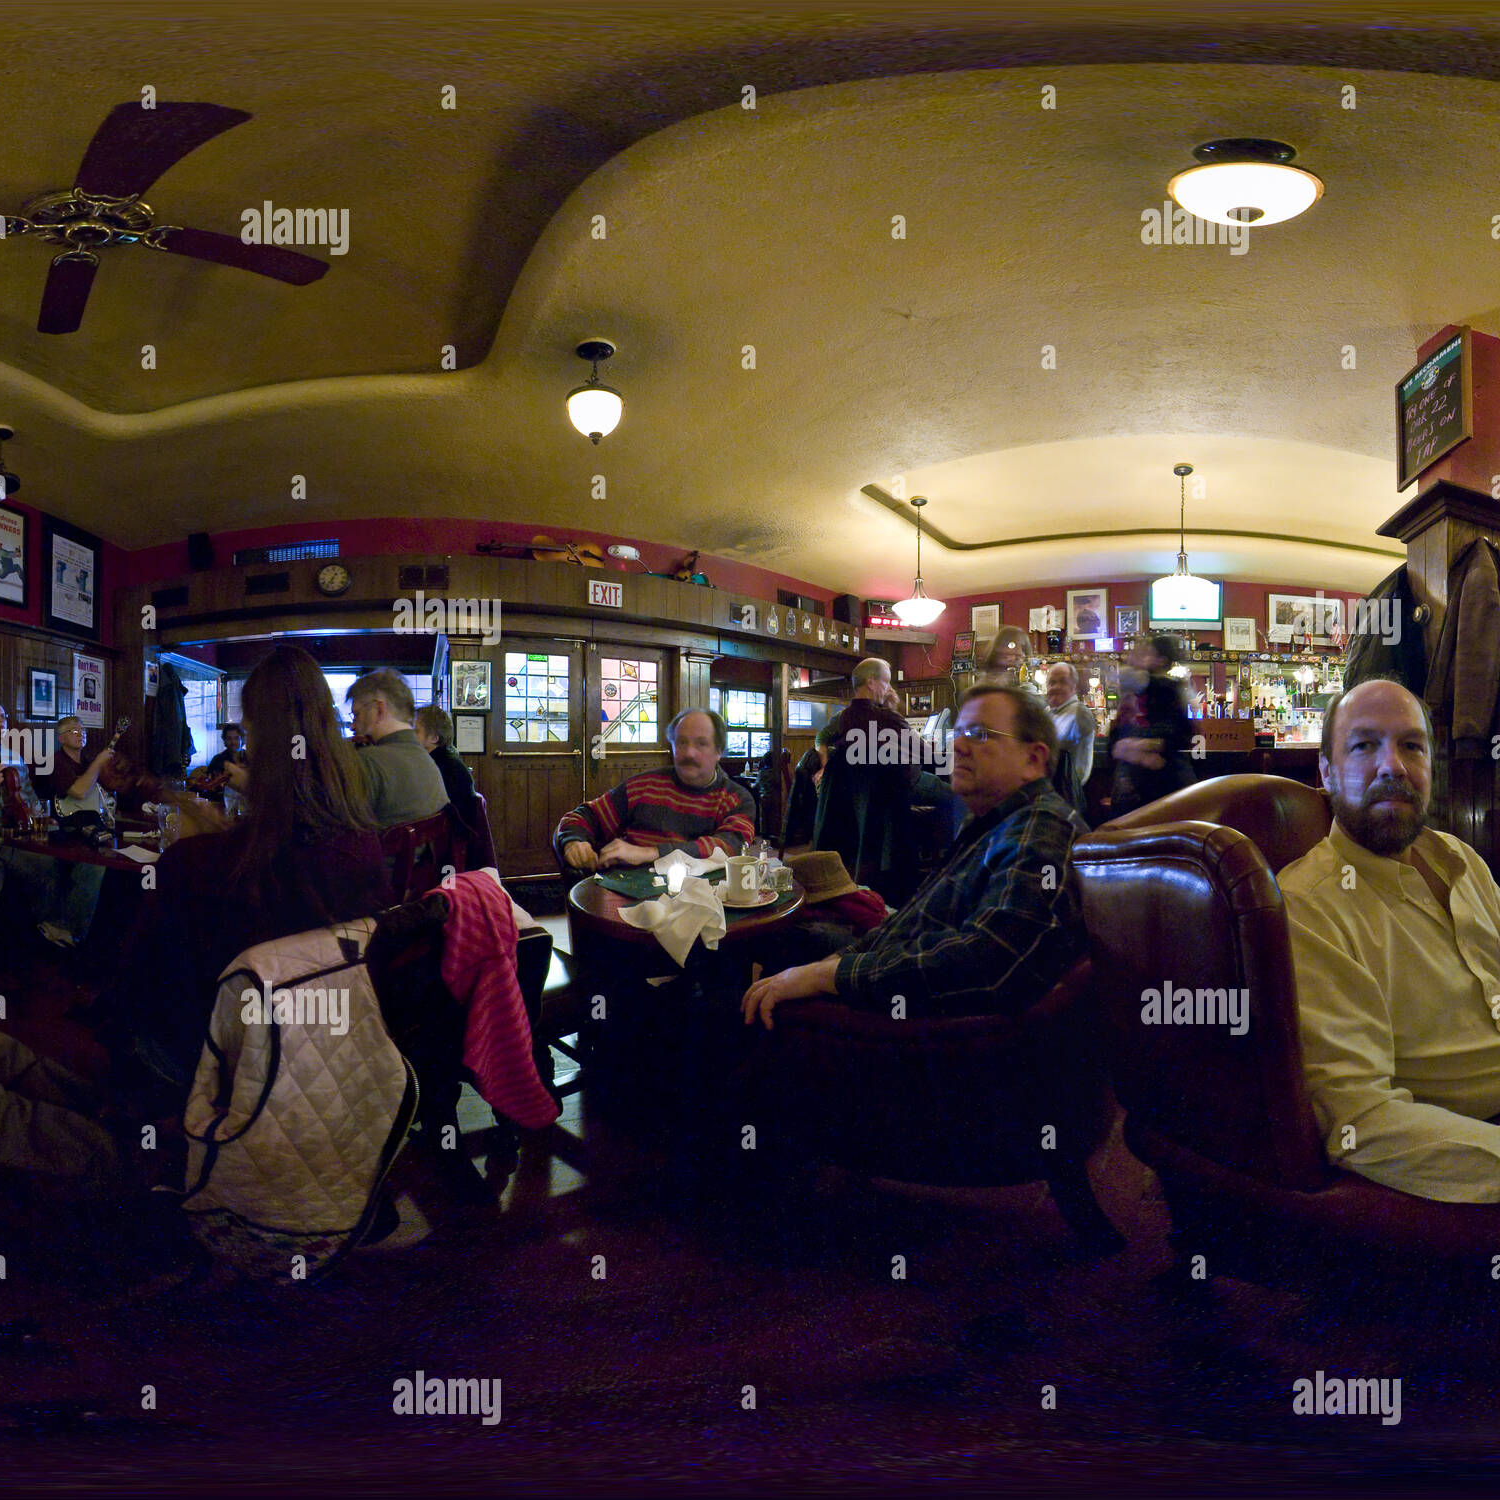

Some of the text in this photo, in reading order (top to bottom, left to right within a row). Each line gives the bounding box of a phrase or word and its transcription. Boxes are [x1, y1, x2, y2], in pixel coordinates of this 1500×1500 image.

[1420, 388, 1437, 410] ONE
[1431, 394, 1447, 415] 22
[1439, 407, 1456, 427] ON
[592, 583, 620, 606] EXIT
[76, 698, 102, 713] Pub Quiz
